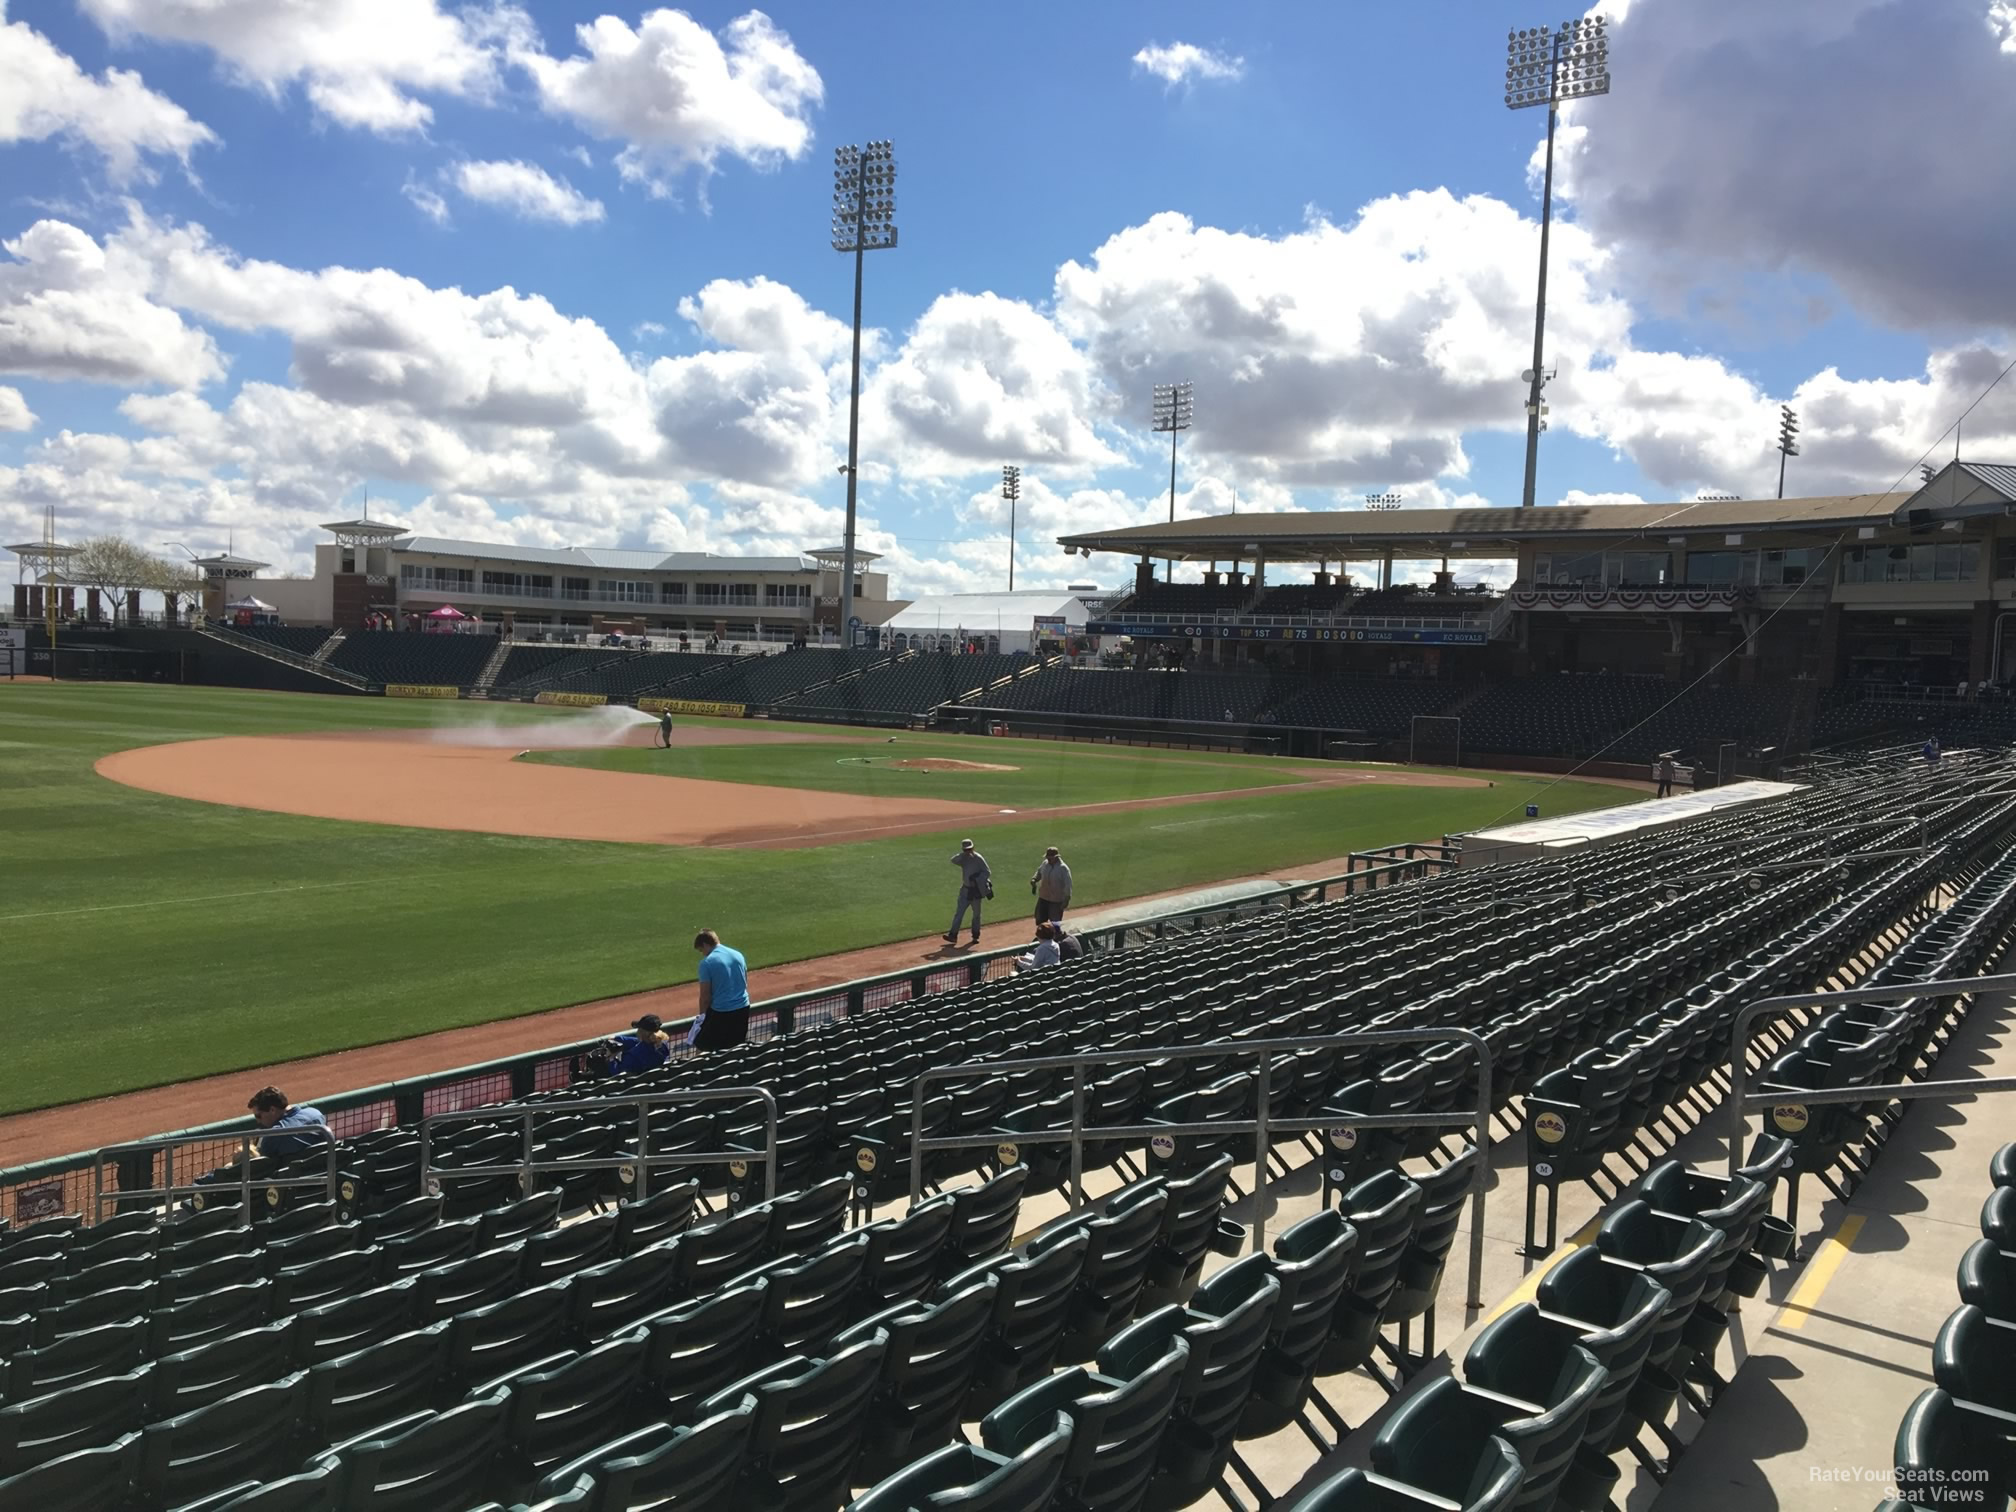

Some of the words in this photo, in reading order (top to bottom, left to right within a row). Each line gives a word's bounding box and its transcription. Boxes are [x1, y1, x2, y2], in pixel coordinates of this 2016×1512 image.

[1222, 628, 1229, 637] 0
[1255, 629, 1270, 637] 1ST
[1296, 630, 1307, 639] 75
[1540, 1165, 1548, 1174] M
